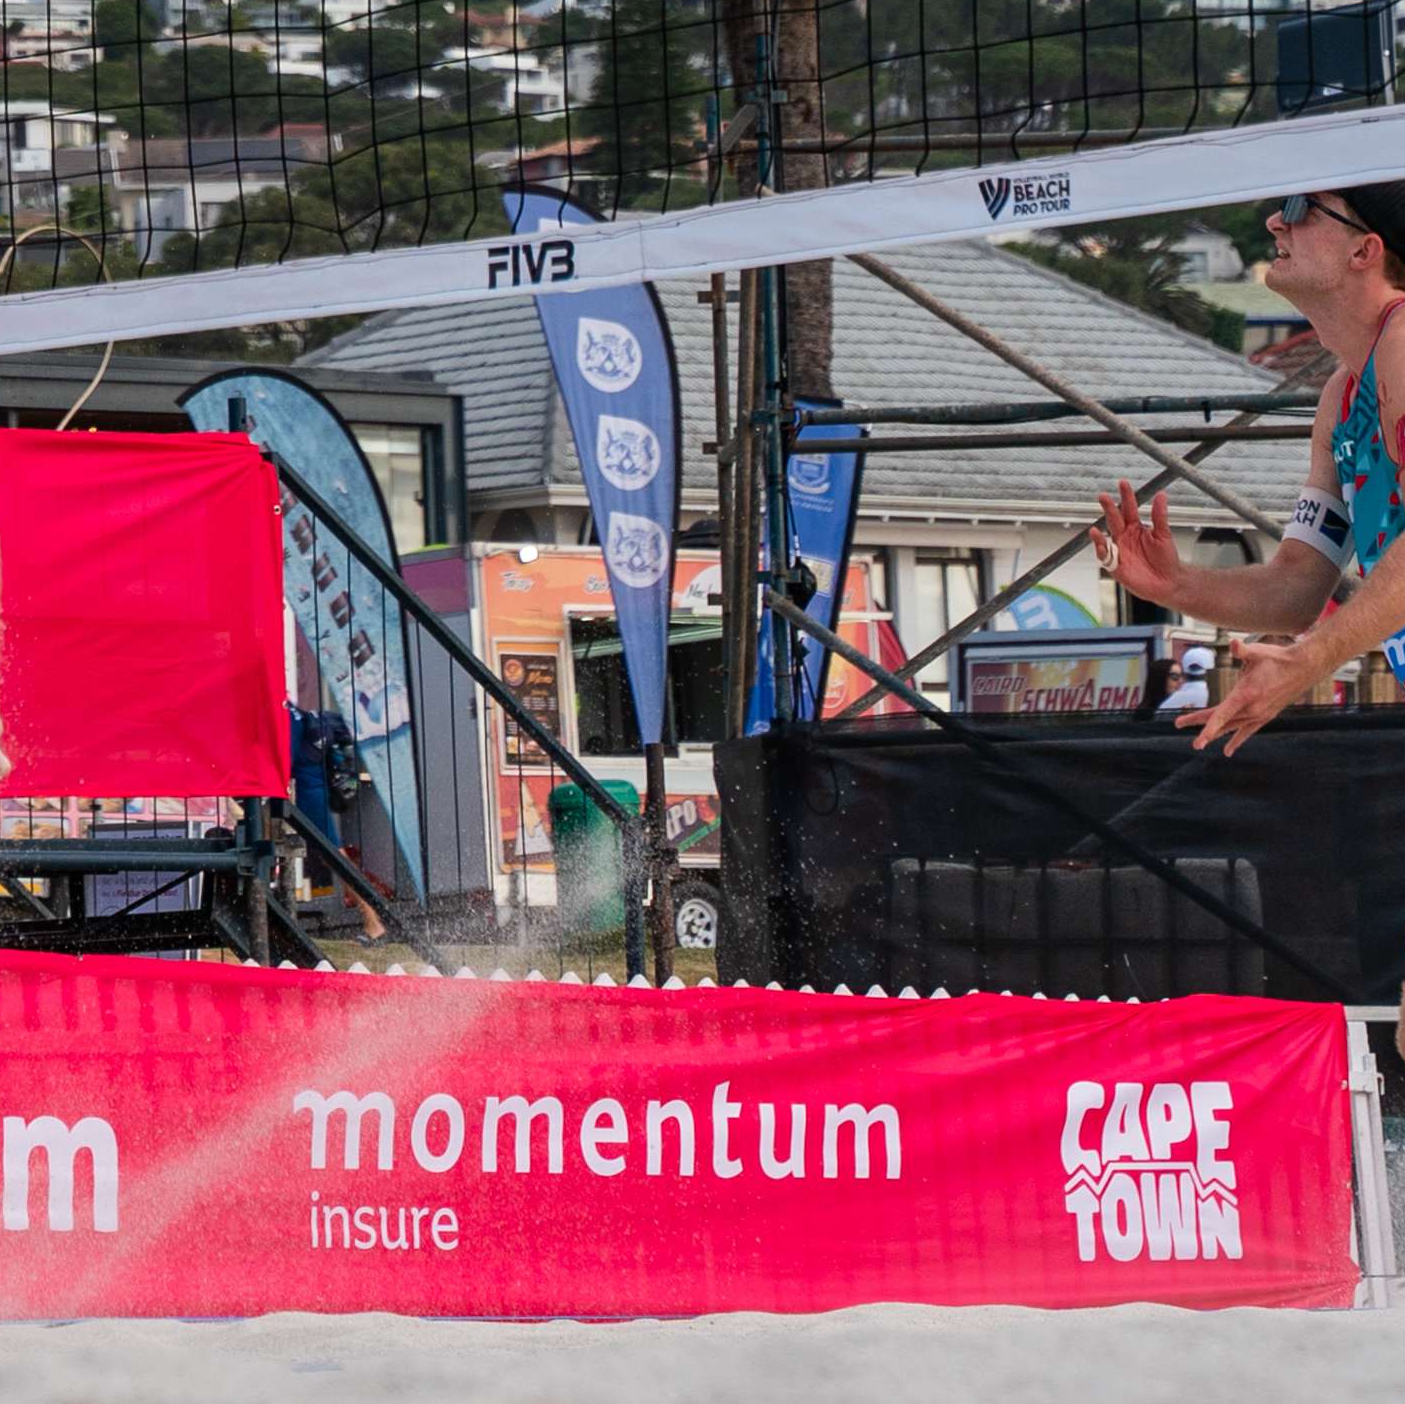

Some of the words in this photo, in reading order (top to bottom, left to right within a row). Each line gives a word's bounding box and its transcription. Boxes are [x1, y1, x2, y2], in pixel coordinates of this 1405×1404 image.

[1013, 179, 1070, 203] BEACH
[1013, 202, 1038, 216] PRO
[1040, 198, 1070, 212] TOUR
[488, 240, 574, 289] FIVB
[293, 1081, 903, 1180] momentum
[1060, 1081, 1236, 1190] CAPE
[310, 1192, 460, 1250] insure
[1065, 1173, 1243, 1261] TOWN
